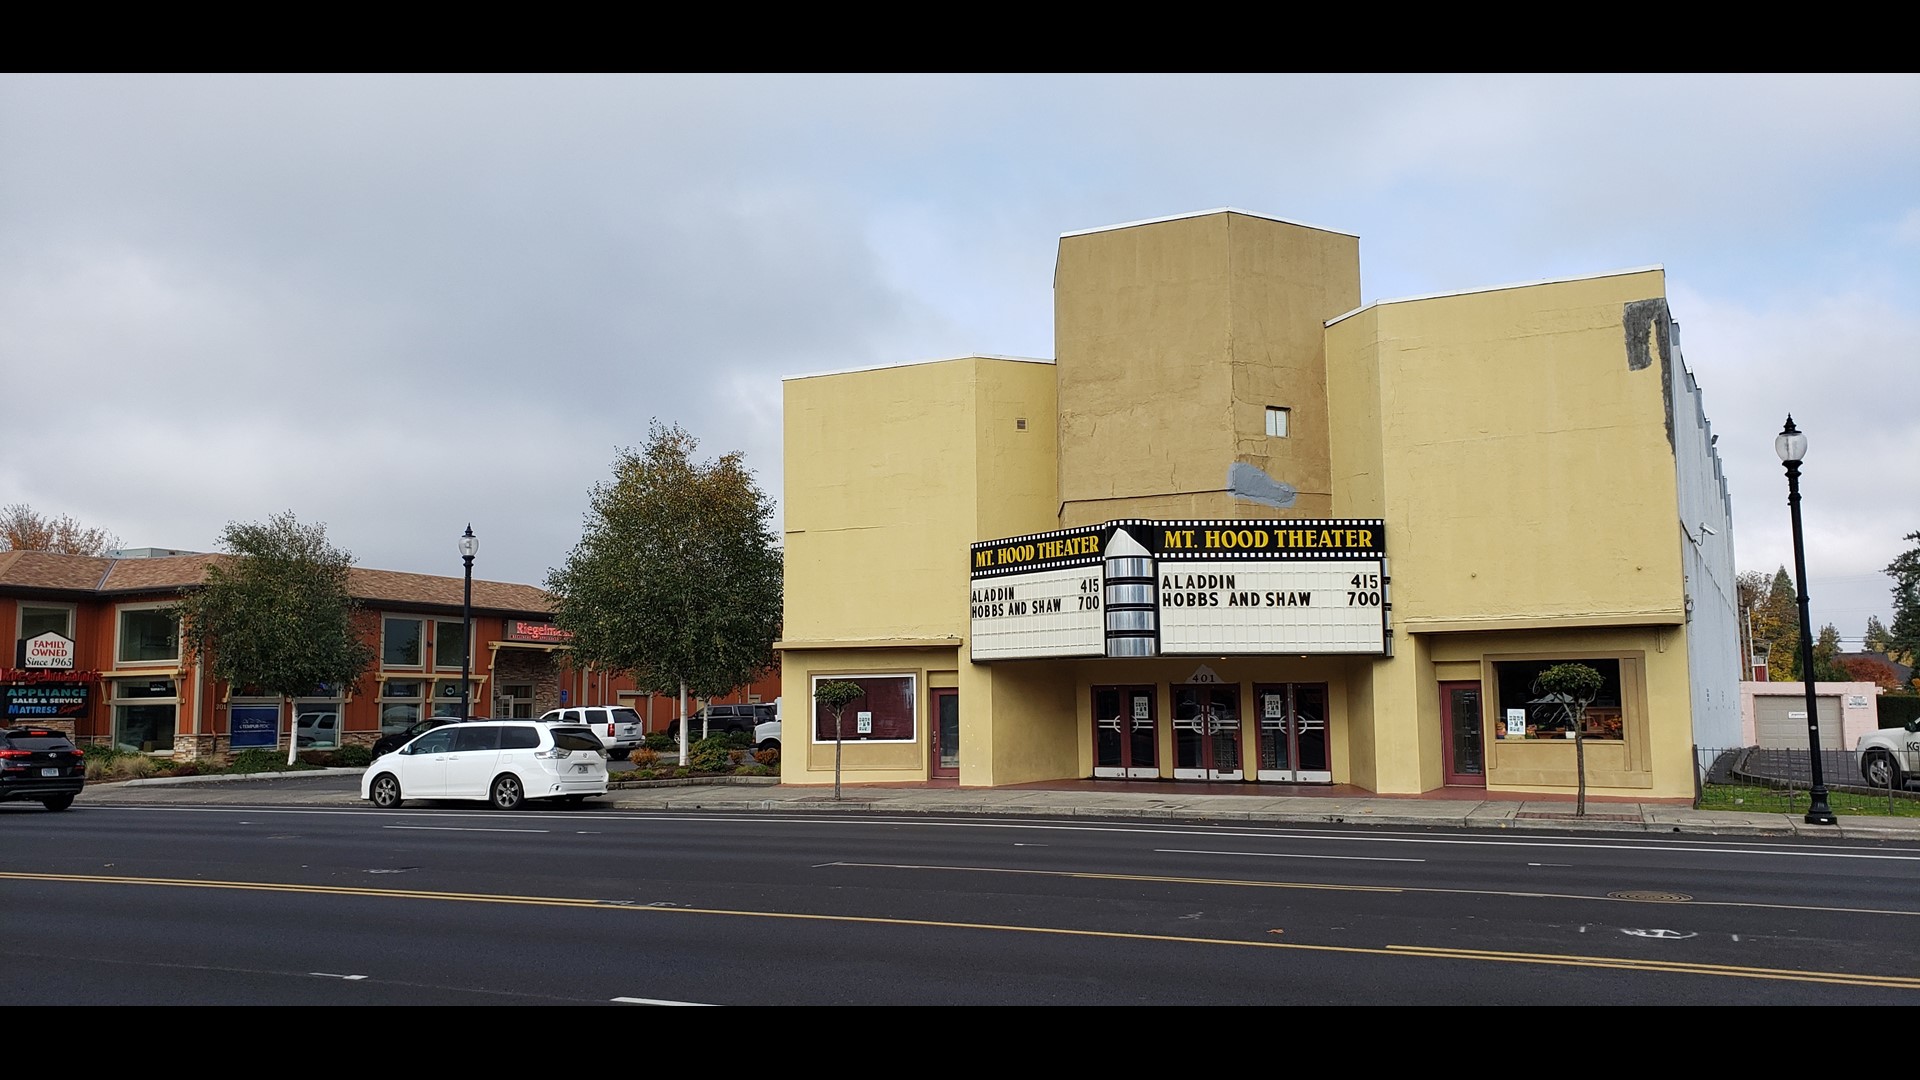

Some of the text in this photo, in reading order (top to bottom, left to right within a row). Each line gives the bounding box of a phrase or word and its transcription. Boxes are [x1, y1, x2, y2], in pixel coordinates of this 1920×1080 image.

[1164, 529, 1373, 549] MT. HOOD THEATER
[975, 535, 1100, 568] MT. HOOD THEATER
[1162, 573, 1379, 590] ALADDIN 415
[971, 578, 1100, 604] ALADDIN 415
[1162, 591, 1380, 607] HOBBS AND SHAW 700
[971, 595, 1100, 619] HOBBS AND SHAW 700
[33, 640, 67, 649] FAMILY
[31, 649, 68, 657] OWNED
[25, 656, 73, 667] Since 1965
[1192, 673, 1216, 683] 401
[7, 688, 87, 697] APPLIANCE
[8, 704, 58, 714] MATTRESS
[1906, 741, 1920, 751] KG
